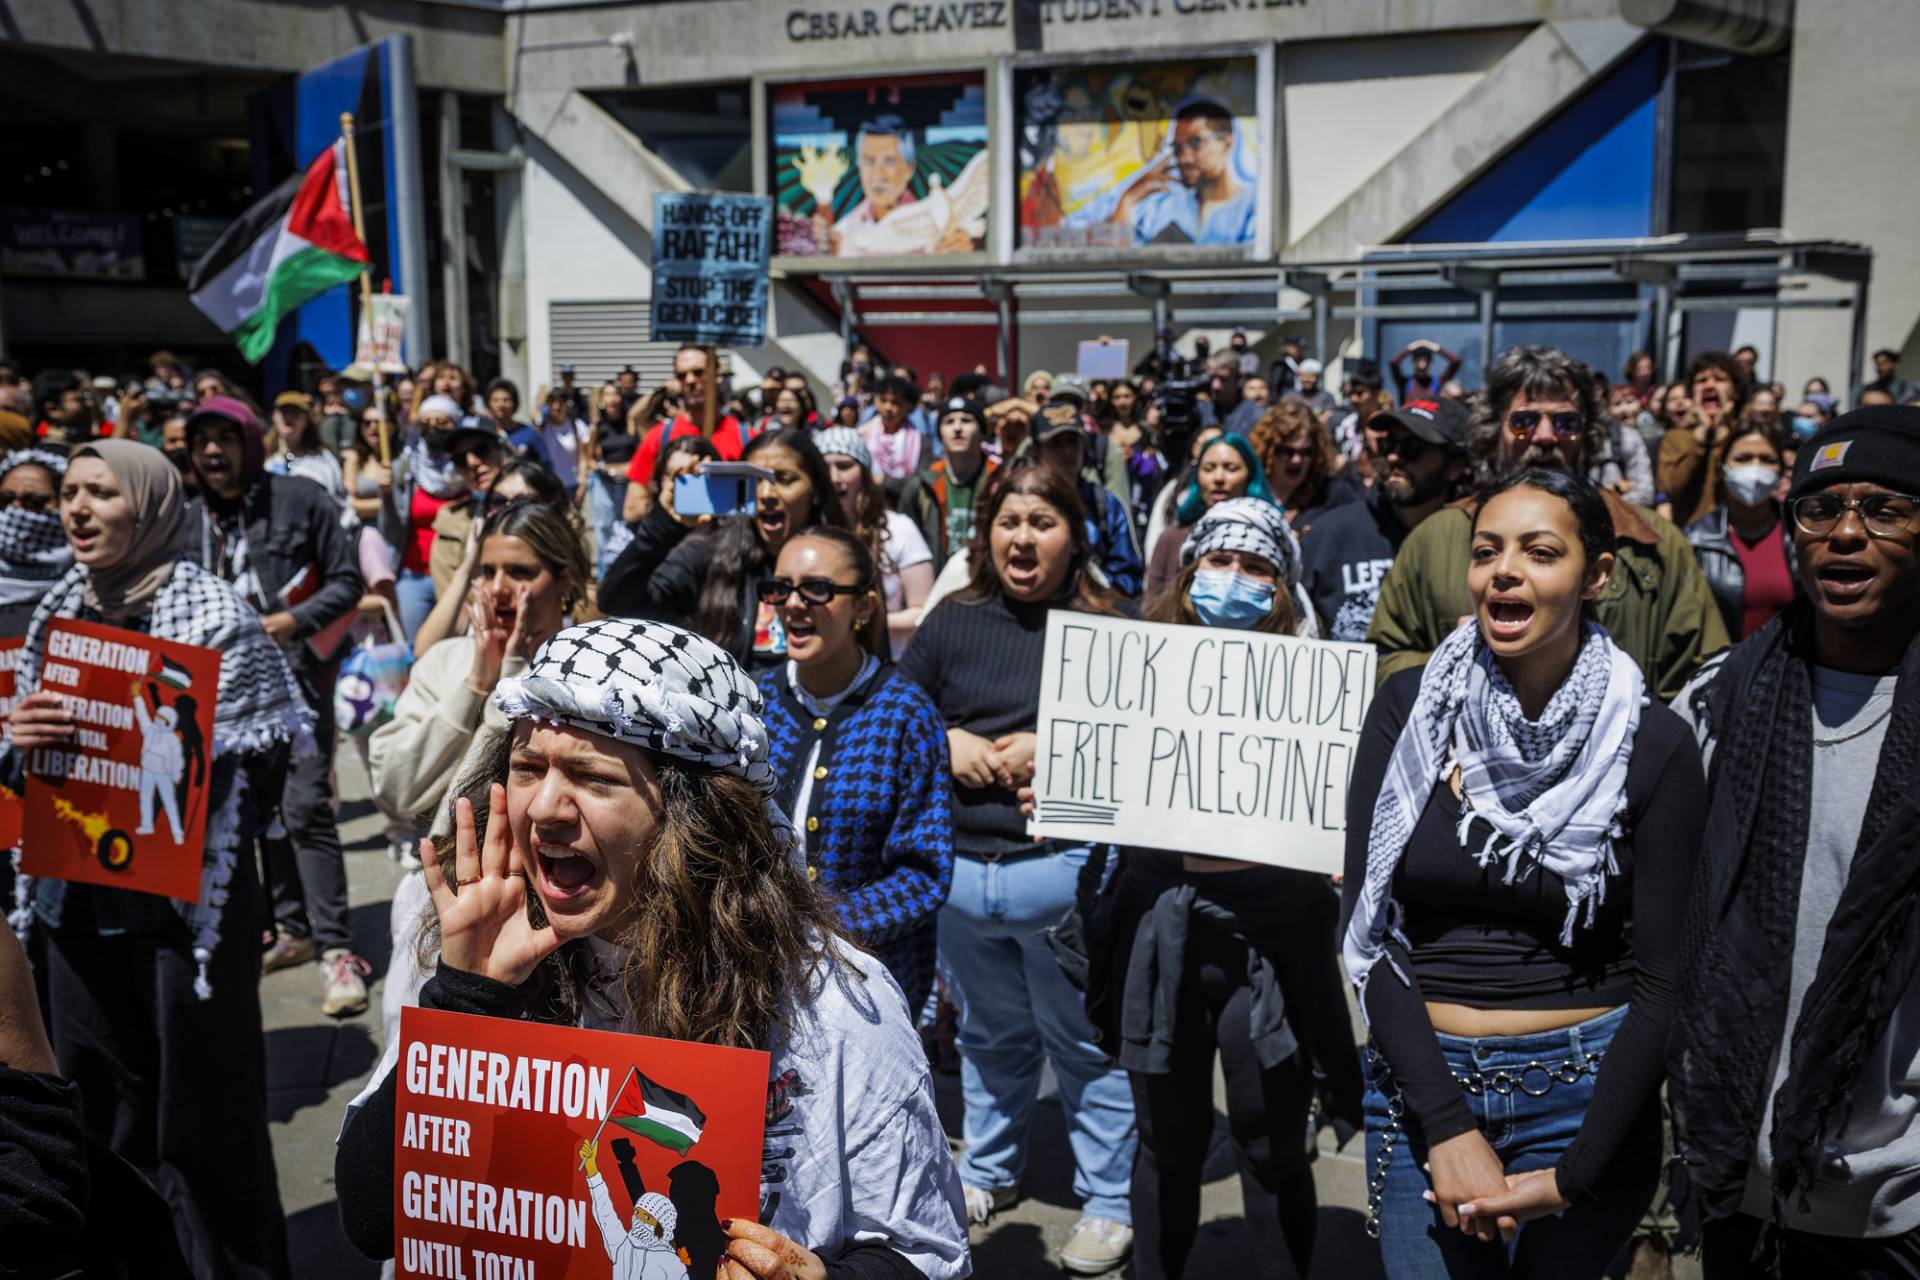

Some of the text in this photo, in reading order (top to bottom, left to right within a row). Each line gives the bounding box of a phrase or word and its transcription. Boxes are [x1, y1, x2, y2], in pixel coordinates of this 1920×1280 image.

[786, 9, 880, 41] CESAR
[888, 1, 1006, 35] CHAVEZ
[1041, 0, 1162, 24] TUDENT
[662, 204, 762, 228] HANDS OFF
[662, 229, 760, 263] RAFAH!
[665, 276, 755, 301] STOP THE
[1341, 558, 1393, 594] LEF
[48, 629, 150, 676] GENERATION
[43, 662, 80, 687] AFTER
[1058, 624, 1368, 734] FUCK GENOCIDE!
[31, 748, 141, 792] LIBERATION
[1047, 718, 1352, 831] FREE PALESTINE!
[405, 1041, 610, 1121] GENERATION
[402, 1112, 471, 1157] AFTER
[402, 1171, 587, 1248] GENERATION
[402, 1237, 467, 1280] UNTIL
